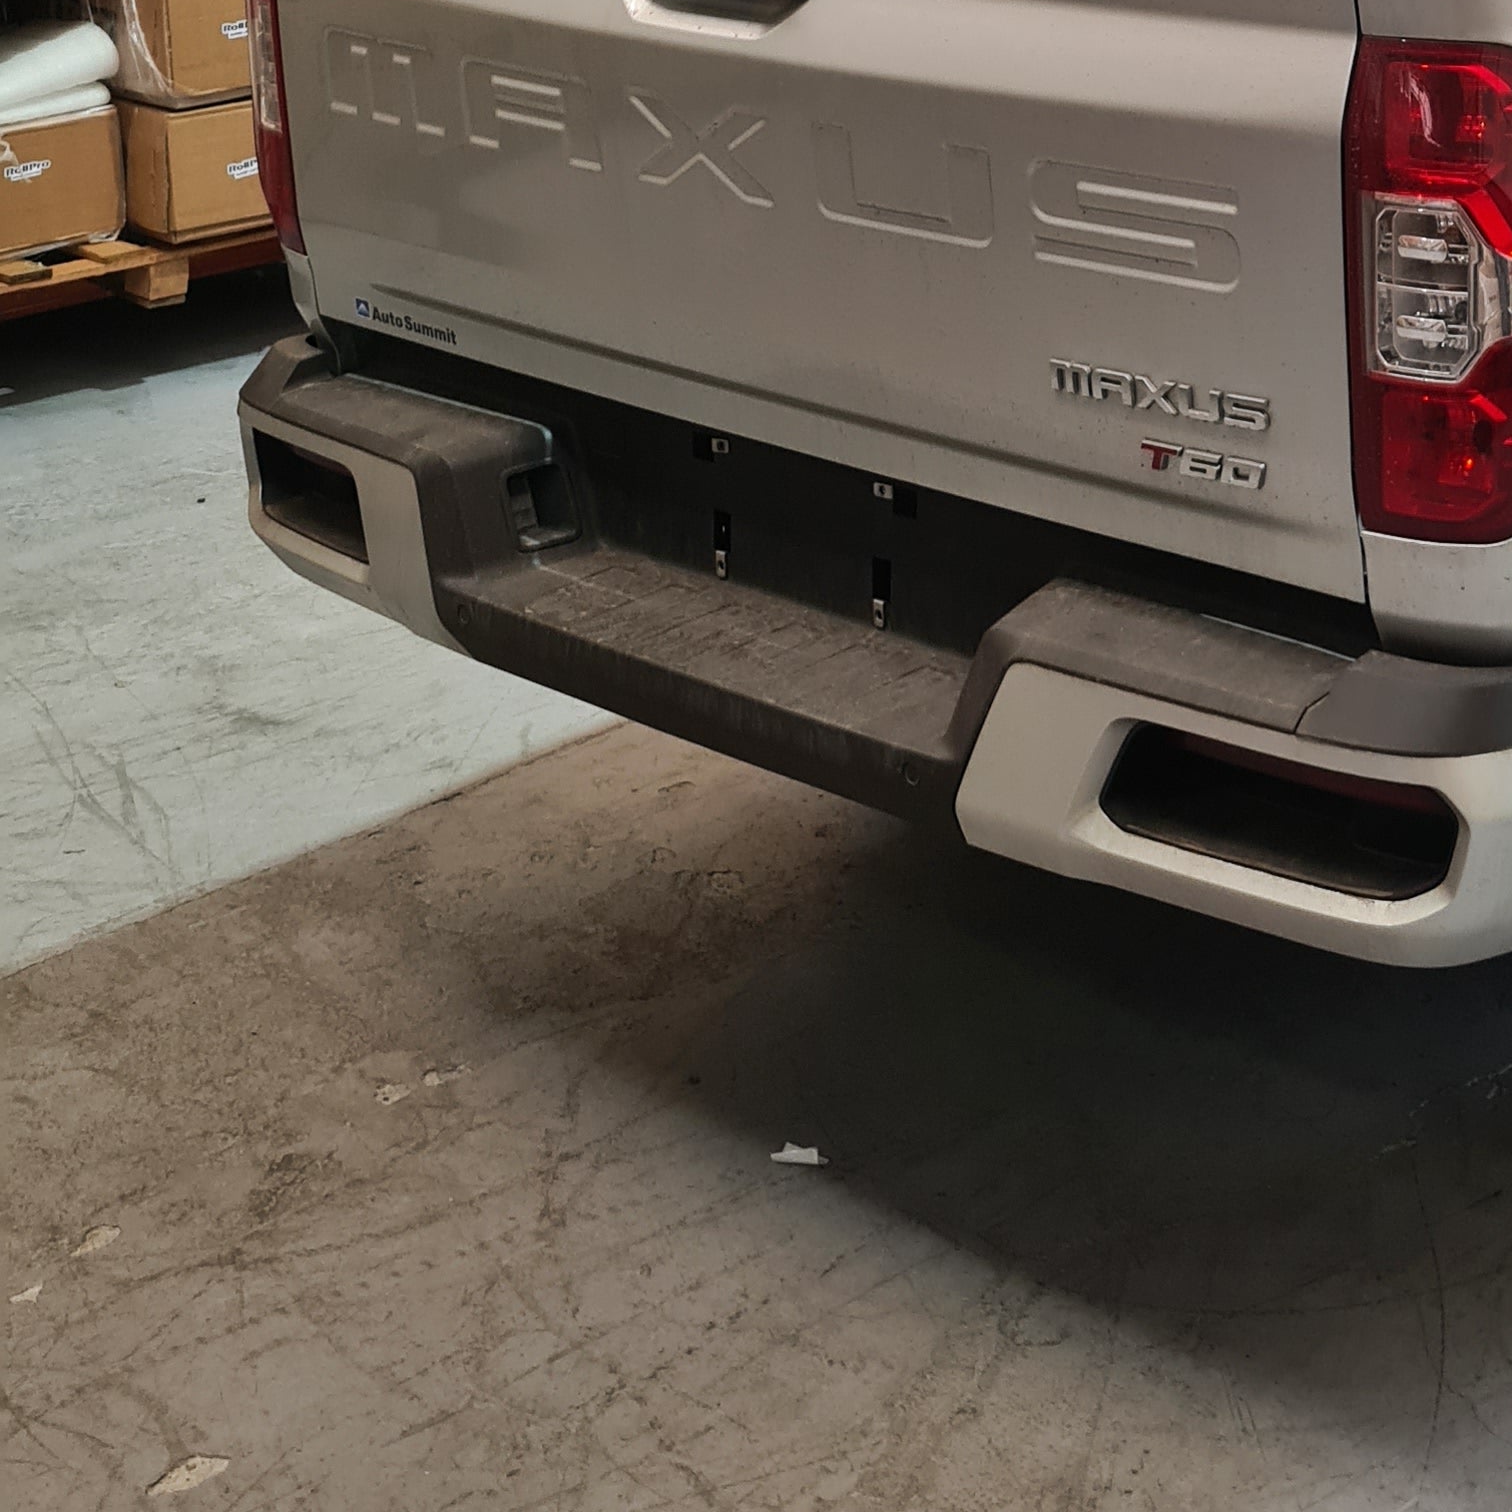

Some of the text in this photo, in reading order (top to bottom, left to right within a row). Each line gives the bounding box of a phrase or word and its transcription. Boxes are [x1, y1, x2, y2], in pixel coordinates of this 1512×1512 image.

[223, 21, 248, 32] Roll
[229, 158, 258, 173] RollP
[323, 24, 1242, 294] MAXUS
[1049, 355, 1271, 433] MAXUS
[1140, 438, 1267, 489] T60
